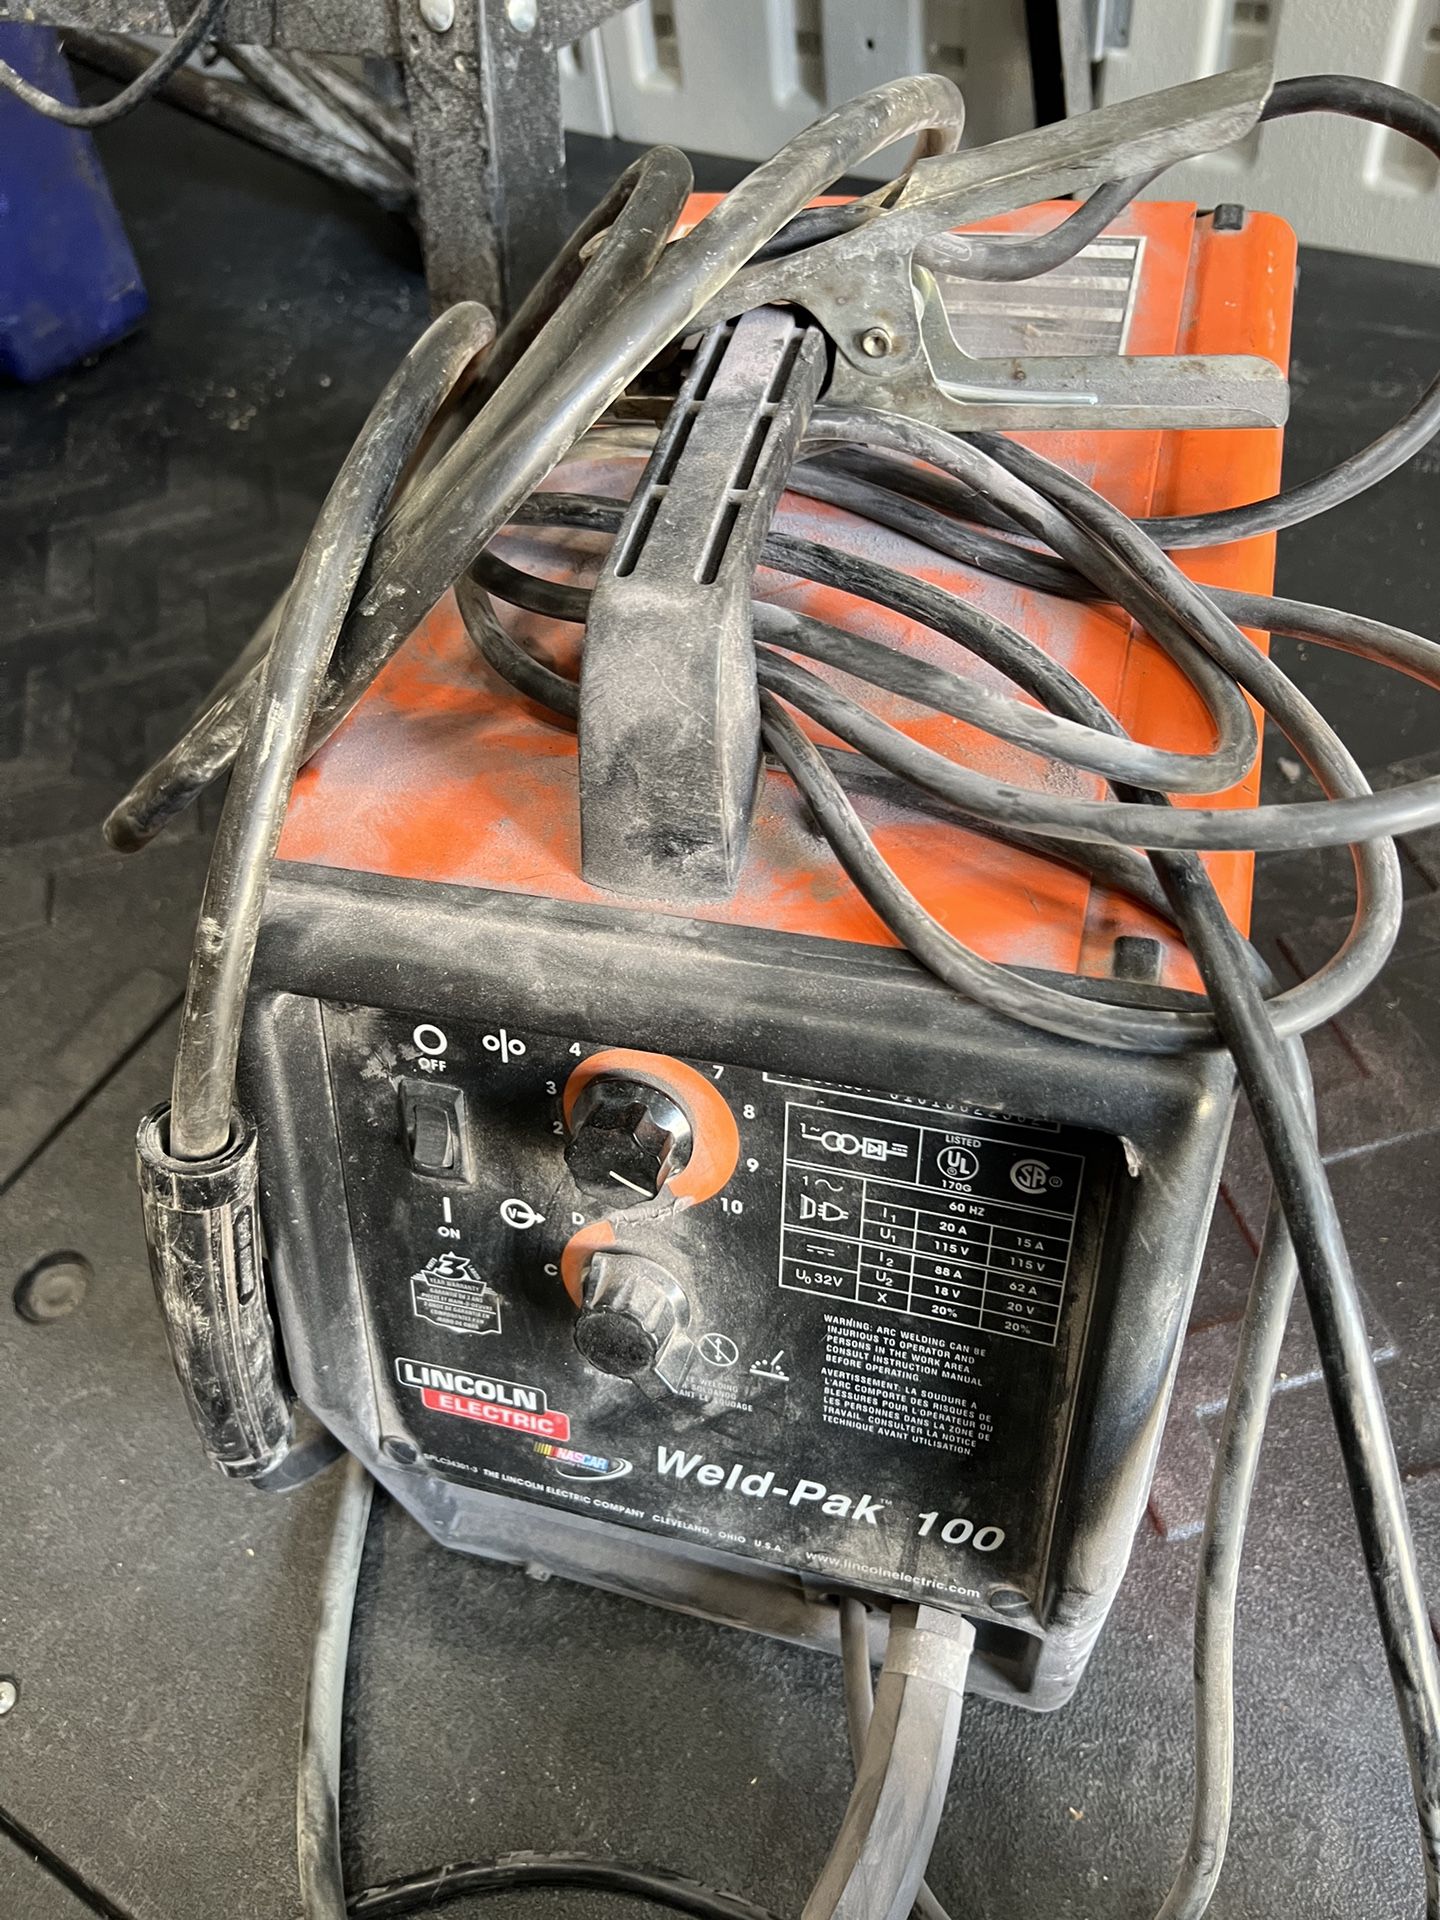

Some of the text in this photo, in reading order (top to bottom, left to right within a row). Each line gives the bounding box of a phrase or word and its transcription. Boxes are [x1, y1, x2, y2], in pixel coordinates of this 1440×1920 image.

[569, 1042, 582, 1056] 4
[418, 1057, 447, 1072] OFF
[712, 1064, 725, 1080] 7
[546, 1080, 558, 1095] 3
[743, 1104, 756, 1120] 8
[553, 1121, 565, 1135] 2
[945, 1134, 982, 1148] LISTED
[746, 1157, 759, 1173] 9
[942, 1179, 972, 1193] 170G
[572, 1211, 585, 1225] D
[720, 1197, 744, 1215] 10
[949, 1202, 986, 1217] 60 HZ
[437, 1226, 461, 1240] ON
[939, 1221, 956, 1233] 20
[957, 1225, 968, 1236] A
[1017, 1236, 1032, 1248] 15
[1034, 1241, 1045, 1251] A
[544, 1263, 559, 1276] C
[934, 1240, 958, 1254] 115
[960, 1246, 970, 1256] V
[1010, 1256, 1033, 1270] 115
[1036, 1262, 1046, 1272] V
[814, 1272, 844, 1287] 32V
[934, 1285, 949, 1297] 18
[952, 1289, 961, 1299] V
[1007, 1301, 1023, 1313] 20
[1026, 1305, 1035, 1315] V
[934, 1265, 951, 1277] 88
[952, 1270, 963, 1280] A
[1009, 1282, 1026, 1293] 62
[1028, 1286, 1038, 1296] A
[877, 1292, 1031, 1335] X 20% 20%
[823, 1314, 987, 1357] WARNING: ARC WELDING CAN BE
[826, 1334, 871, 1351] PERSONS
[875, 1345, 885, 1355] IN
[889, 1348, 908, 1359] THE
[911, 1353, 941, 1367] WORK
[827, 1325, 975, 1364] INJURIOUS TO OPERATOR AND
[825, 1353, 922, 1383] BEFORE OPERATING.
[826, 1344, 983, 1387] CONSULT INSTRUCTION MANUAL
[404, 1363, 538, 1411] LINCOLN
[824, 1377, 992, 1423] L'ARC COMPORTE DES RISQUES DE
[905, 1386, 917, 1396] LA
[921, 1389, 967, 1407] SOUDURE
[970, 1401, 978, 1410] A
[439, 1395, 555, 1435] ELECTRIC
[823, 1396, 991, 1442] LES PERSONNES DANS LA ZONE DE
[824, 1386, 878, 1405] BLESSURES
[882, 1400, 908, 1413] POUR
[979, 1423, 993, 1433] OU
[822, 1414, 974, 1457] TECHNIQUE AVANT UTILISATION.
[868, 1415, 923, 1435] CONSULTER
[926, 1429, 939, 1439] LA
[942, 1433, 977, 1448] NOTICE
[557, 1446, 608, 1471] NASCAR
[482, 1468, 501, 1481] THE
[501, 1473, 545, 1493] LINCOLN
[546, 1486, 591, 1505] ELECTRIC
[592, 1499, 645, 1520] COMPANY
[718, 1530, 747, 1544] OHIO
[916, 1510, 1006, 1552] 100
[805, 1550, 982, 1599] www.lincolnelectric.com
